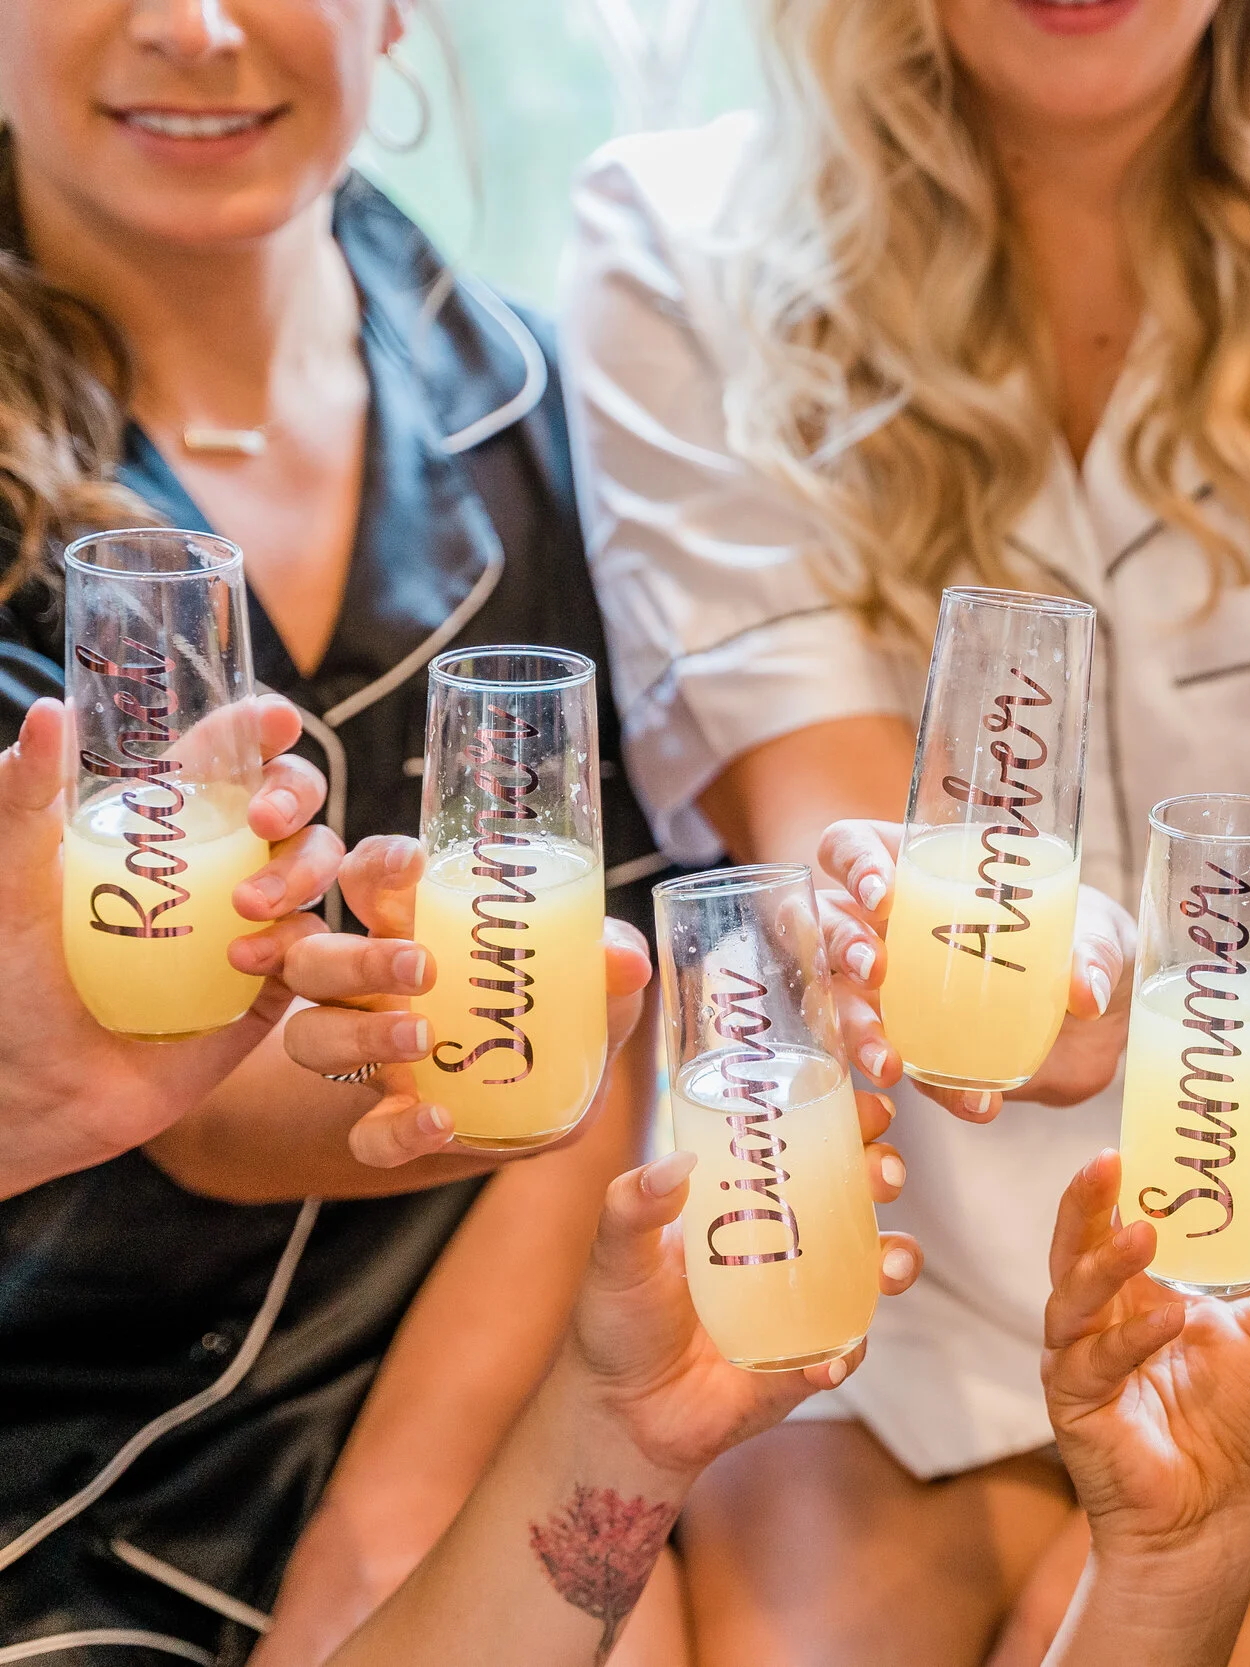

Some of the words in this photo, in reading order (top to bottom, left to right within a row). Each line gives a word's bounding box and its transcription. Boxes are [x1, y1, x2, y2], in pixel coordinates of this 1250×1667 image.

[75, 636, 193, 938] Rachel
[432, 704, 540, 1085] Summer
[932, 668, 1053, 972] Amber
[707, 967, 803, 1267] Diana
